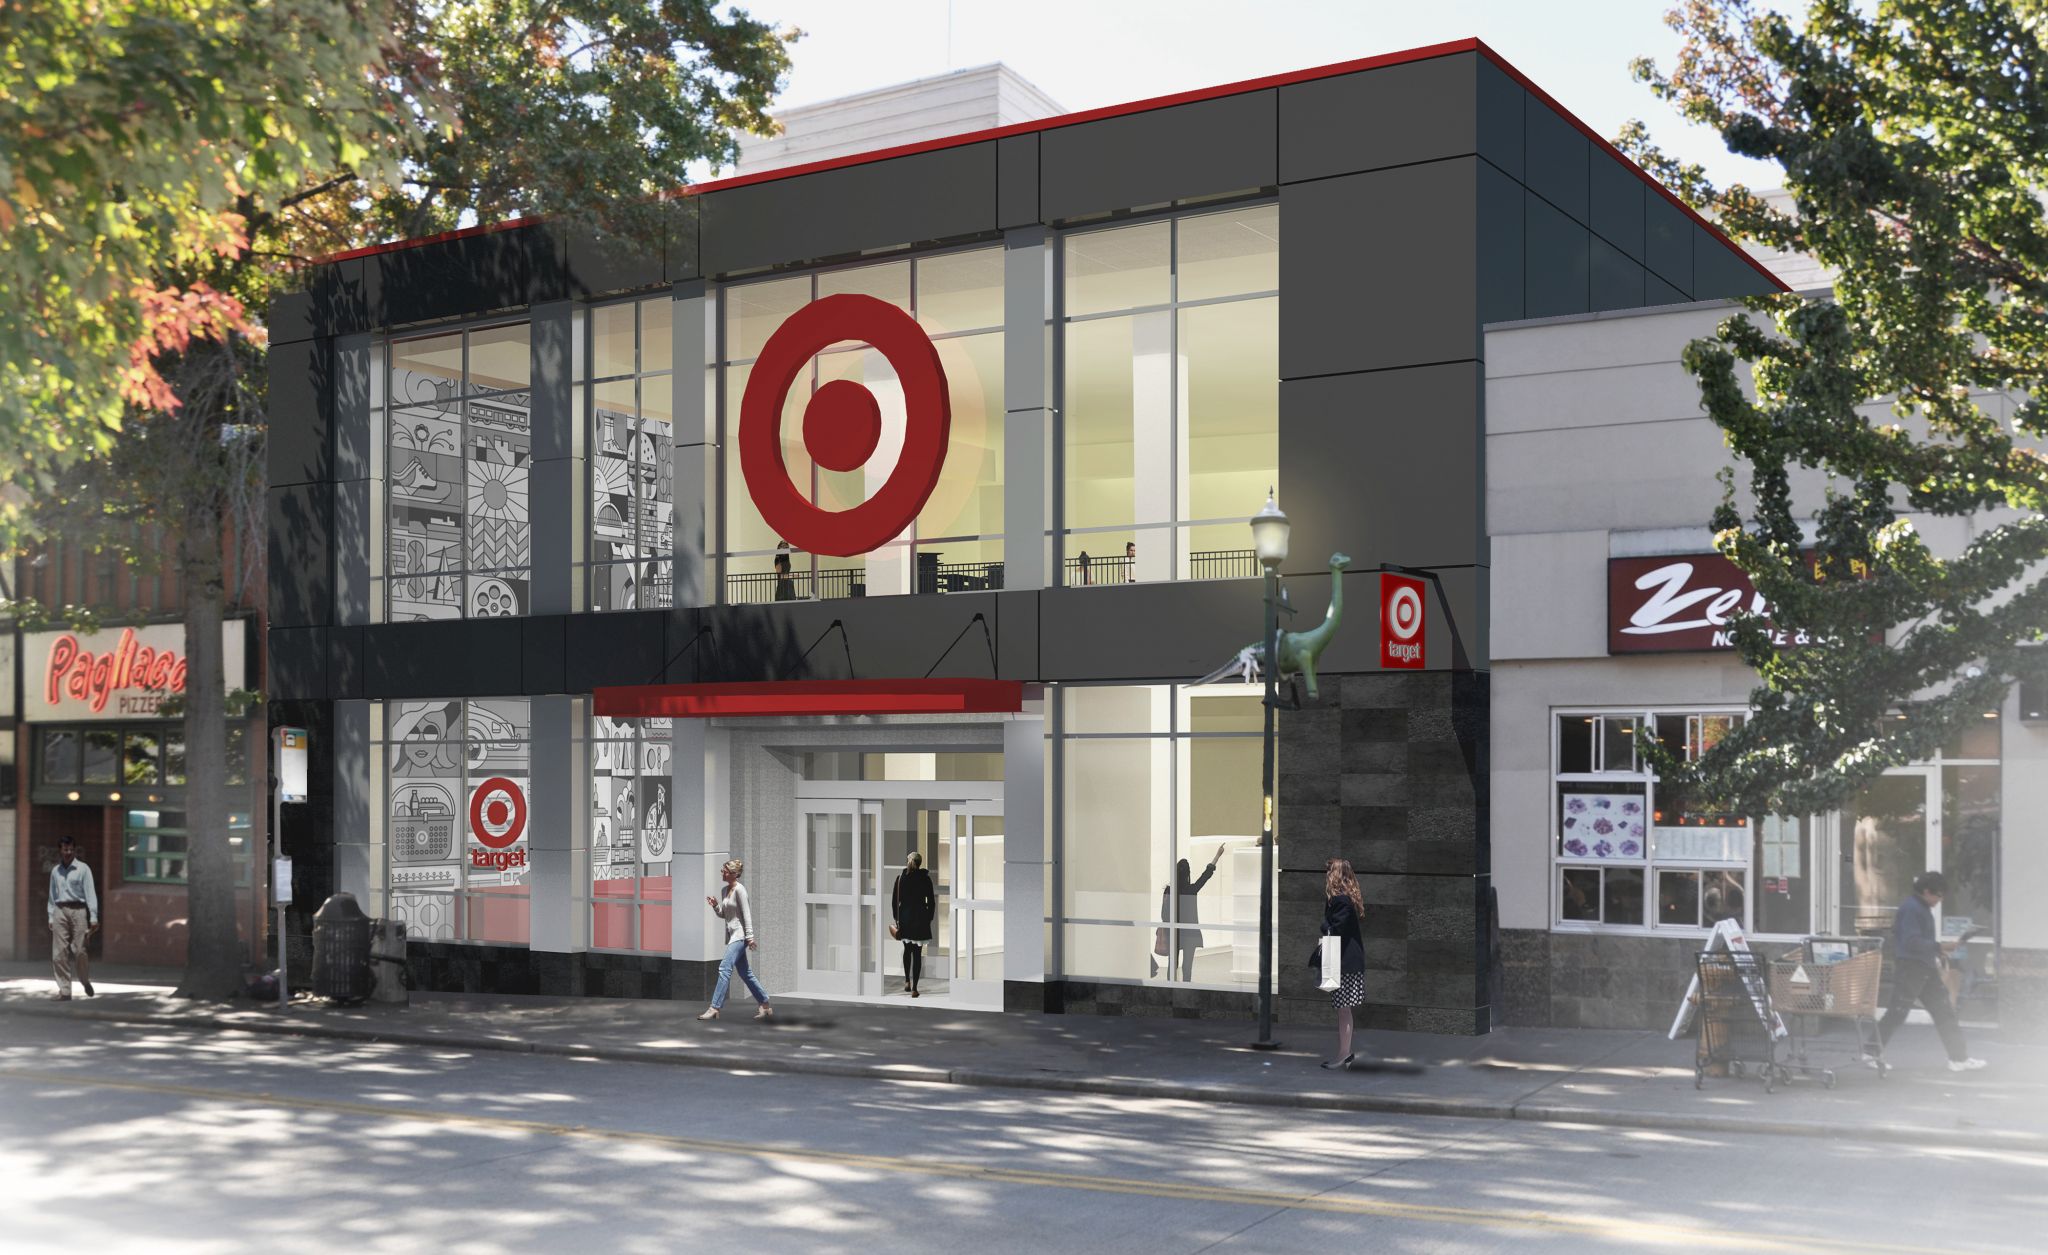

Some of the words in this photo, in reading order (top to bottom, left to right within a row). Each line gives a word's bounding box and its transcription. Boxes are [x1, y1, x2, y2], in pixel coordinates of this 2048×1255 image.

[1389, 640, 1420, 662] target
[44, 628, 187, 712] Pagliacc
[472, 848, 526, 871] target
